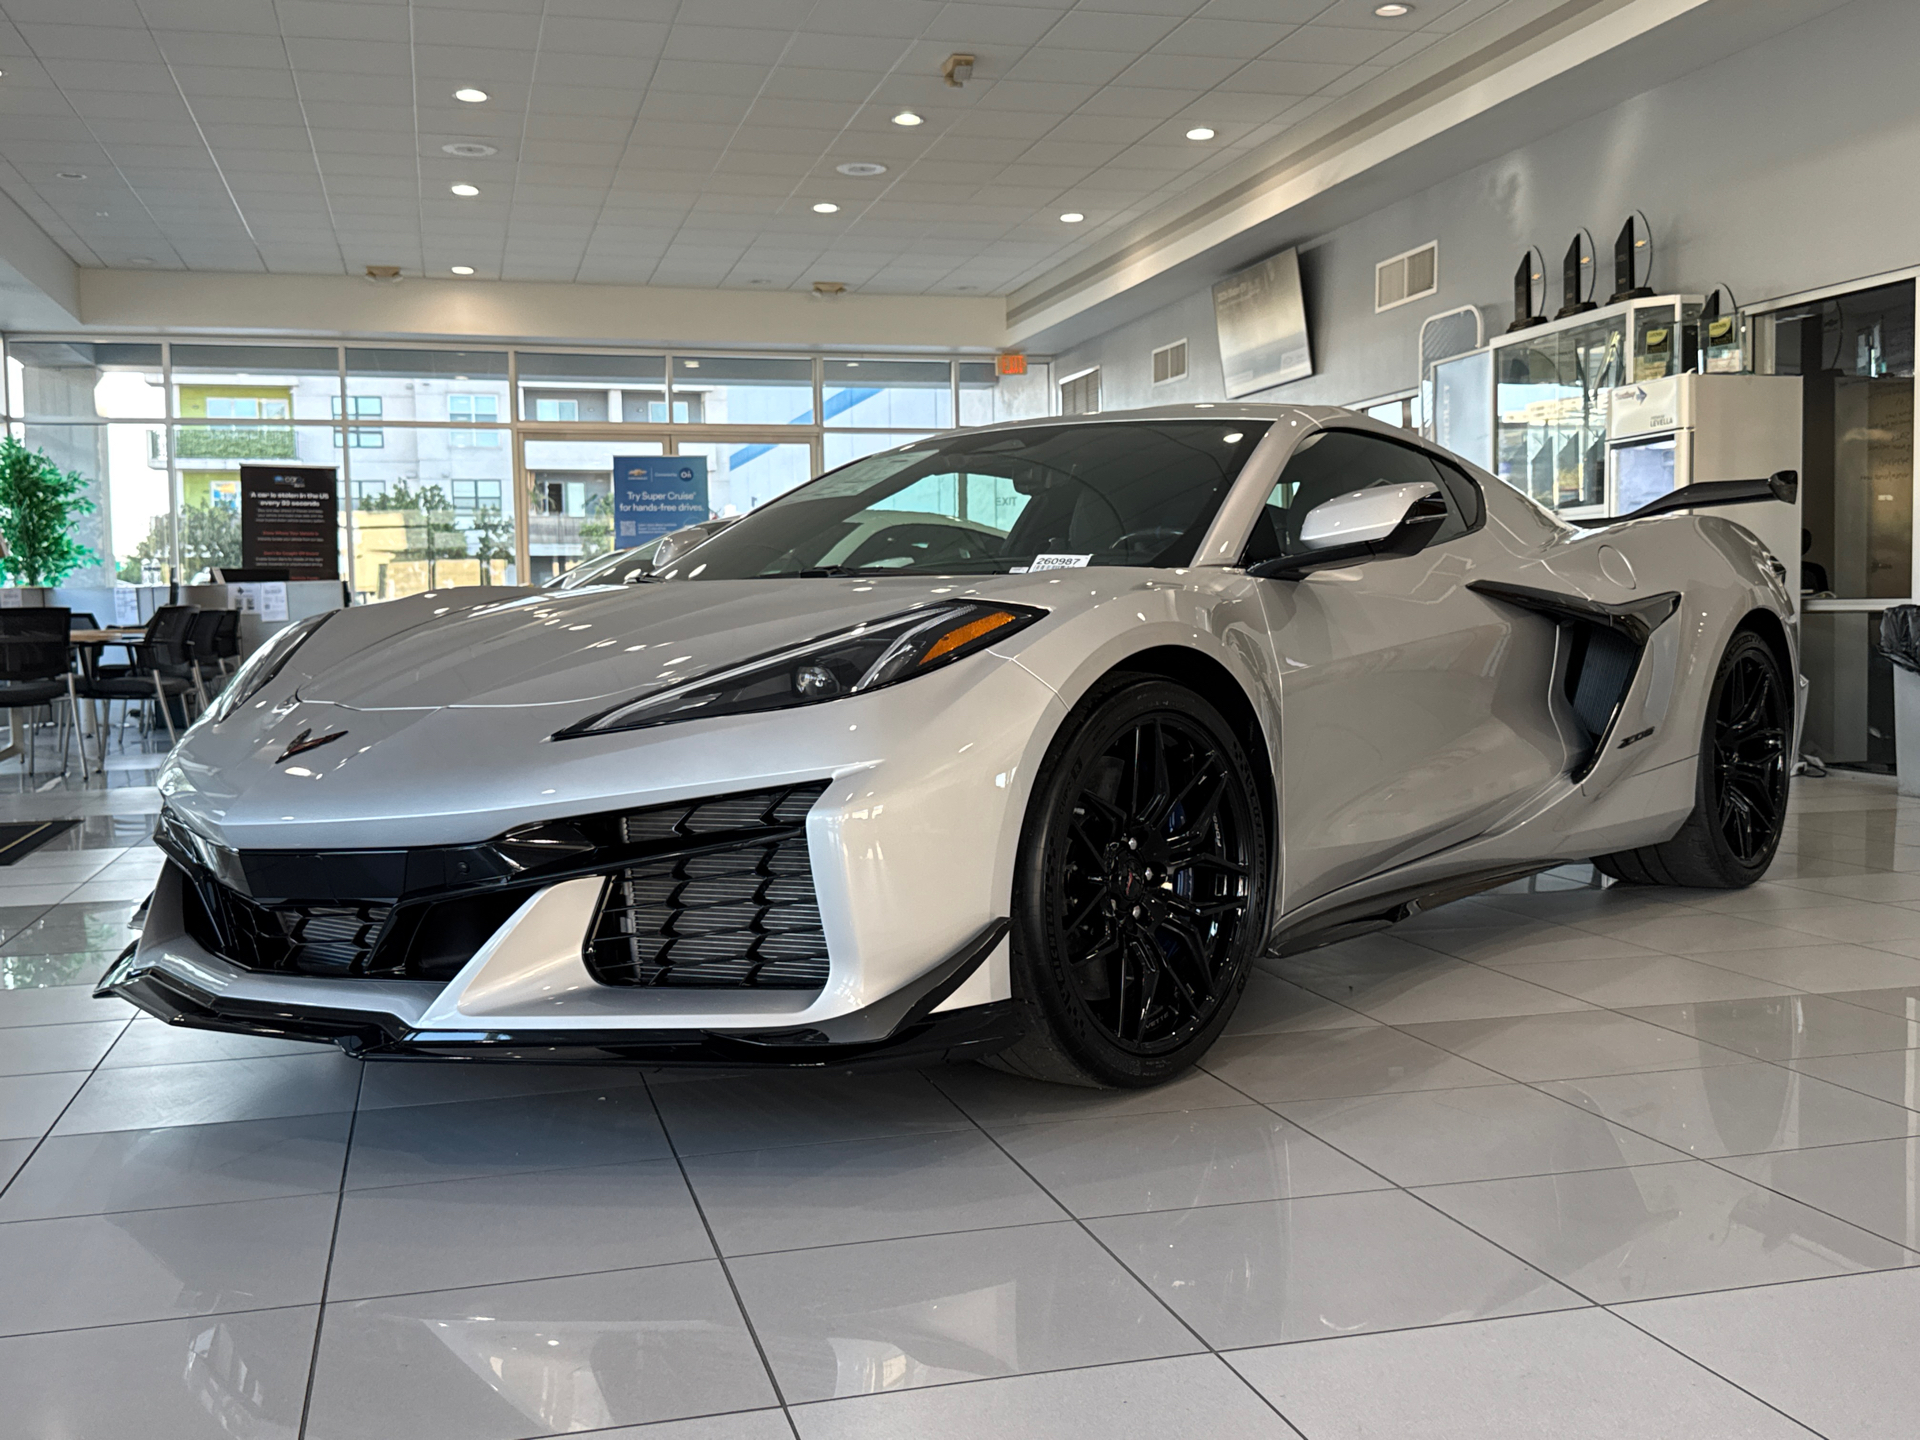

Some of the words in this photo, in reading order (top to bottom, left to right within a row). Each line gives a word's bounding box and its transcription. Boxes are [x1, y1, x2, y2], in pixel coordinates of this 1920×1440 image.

[1002, 355, 1023, 374] EXIT
[1650, 417, 1673, 427] LEVELLA
[250, 491, 257, 499] A
[626, 491, 641, 502] Try
[641, 491, 666, 502] Super
[996, 496, 1018, 507] EXIT
[619, 503, 632, 511] for
[632, 503, 677, 511] hands-free
[678, 503, 705, 511] drives.
[1036, 557, 1082, 565] 260987
